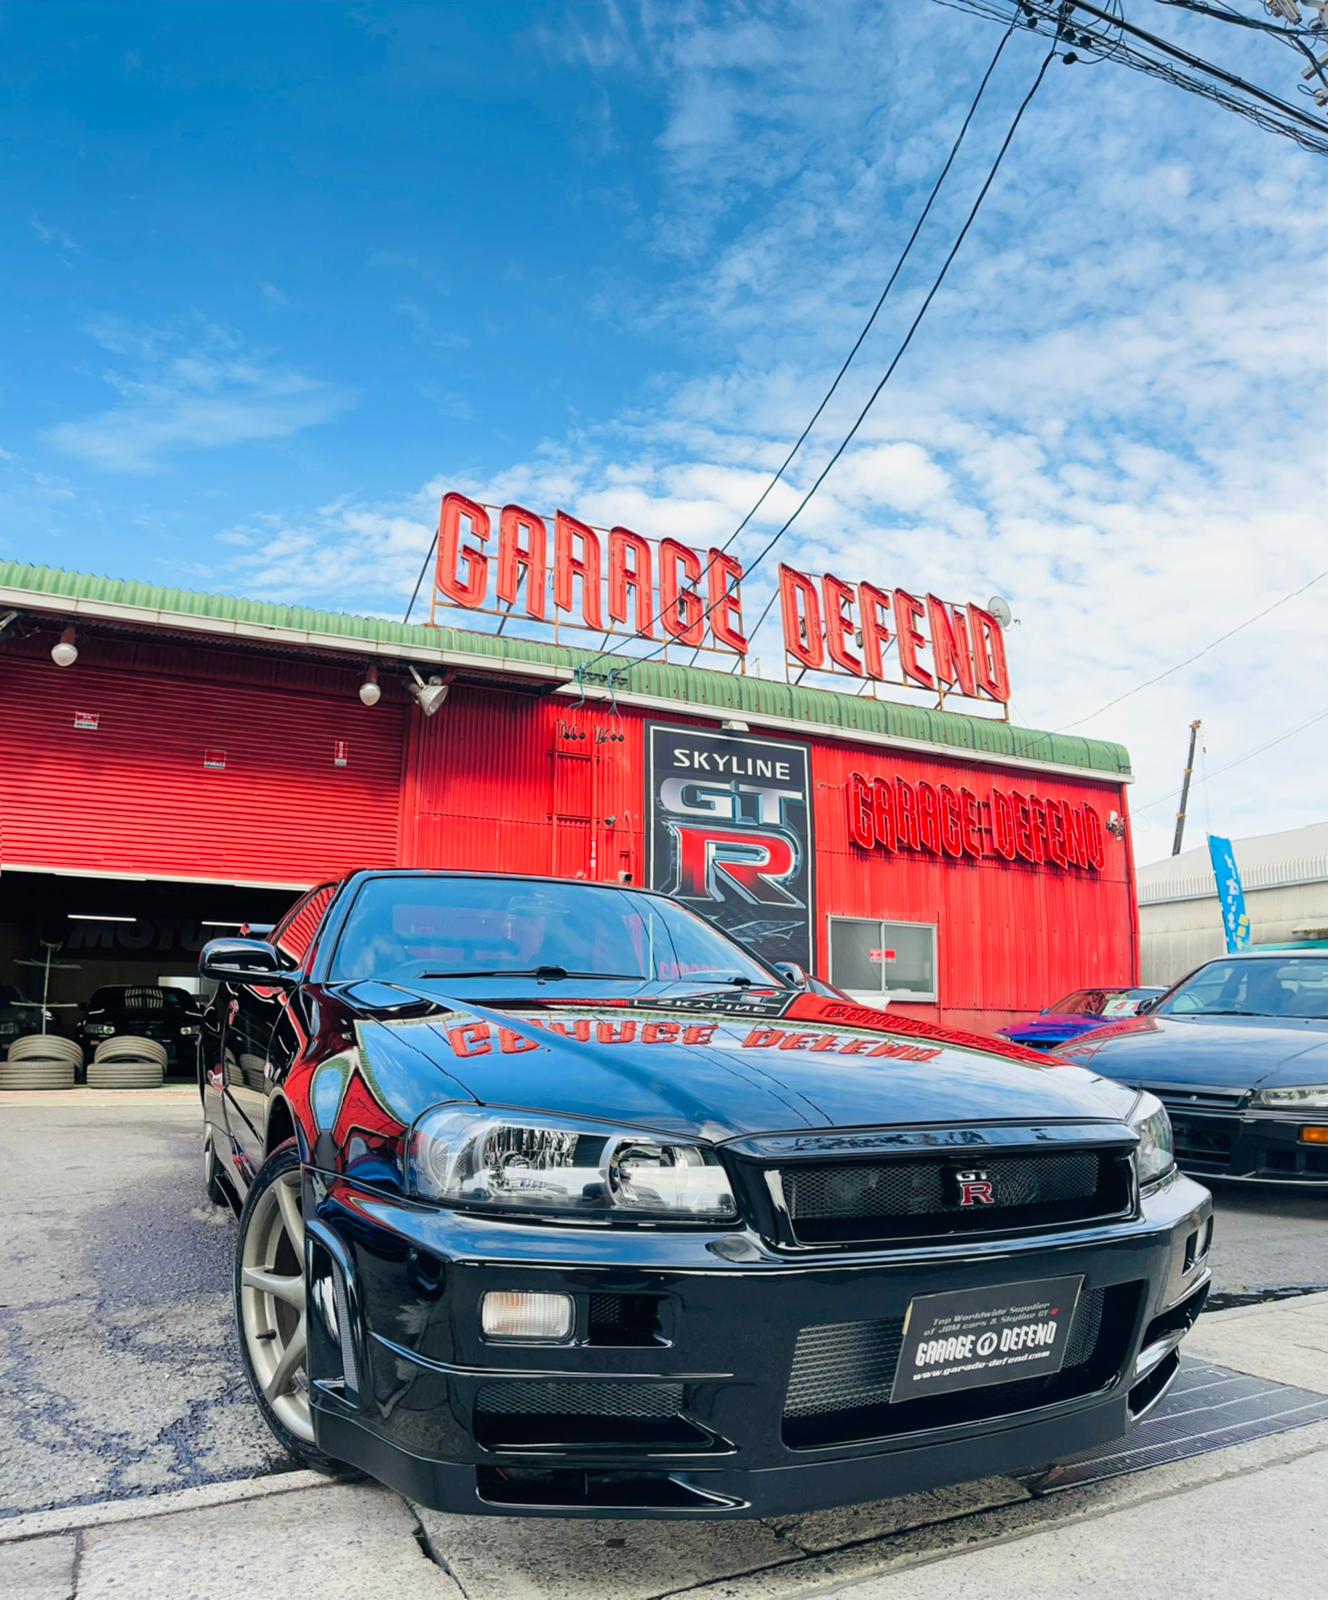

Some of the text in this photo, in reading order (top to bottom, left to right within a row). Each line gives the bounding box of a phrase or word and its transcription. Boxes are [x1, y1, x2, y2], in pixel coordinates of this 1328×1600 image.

[434, 491, 1011, 702] GARAGE DEFEND
[673, 748, 791, 781] SKYLINE
[659, 777, 805, 828] GT
[848, 771, 1105, 872] GARAGE DEFEND
[664, 822, 808, 909] R
[923, 1328, 936, 1337] of
[938, 1322, 961, 1334] JDM
[962, 1320, 987, 1329] cars
[1000, 1311, 1036, 1324] Skyline
[933, 1302, 1051, 1327] Top Worldwide Supplier
[912, 1350, 1051, 1380] www.garage-defend.com
[915, 1334, 976, 1367] GARAGE
[999, 1321, 1057, 1352] DEFEND
